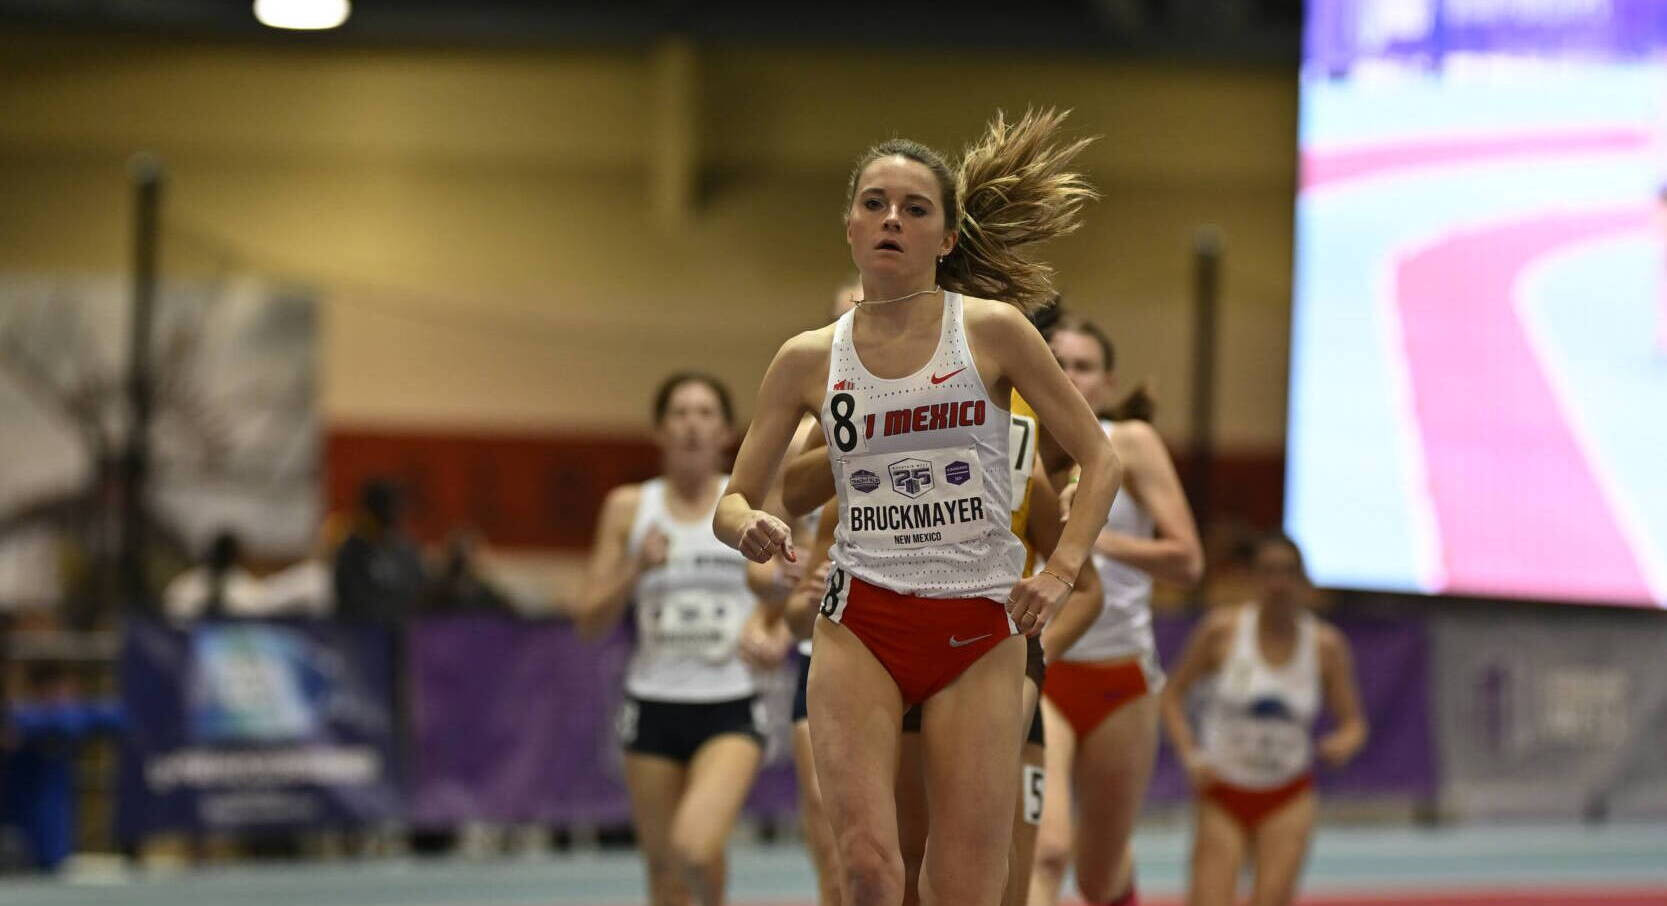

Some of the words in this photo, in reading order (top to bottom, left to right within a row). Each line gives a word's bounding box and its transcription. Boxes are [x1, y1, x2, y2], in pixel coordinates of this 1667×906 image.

[831, 393, 857, 452] 8
[884, 400, 986, 437] MEXICO
[1012, 418, 1030, 470] 7
[893, 467, 931, 487] 25
[851, 497, 984, 532] BRUCKMAYER
[894, 535, 911, 544] NEW
[912, 532, 942, 543] MEXICO
[821, 567, 845, 617] 8
[1031, 773, 1043, 819] 5
